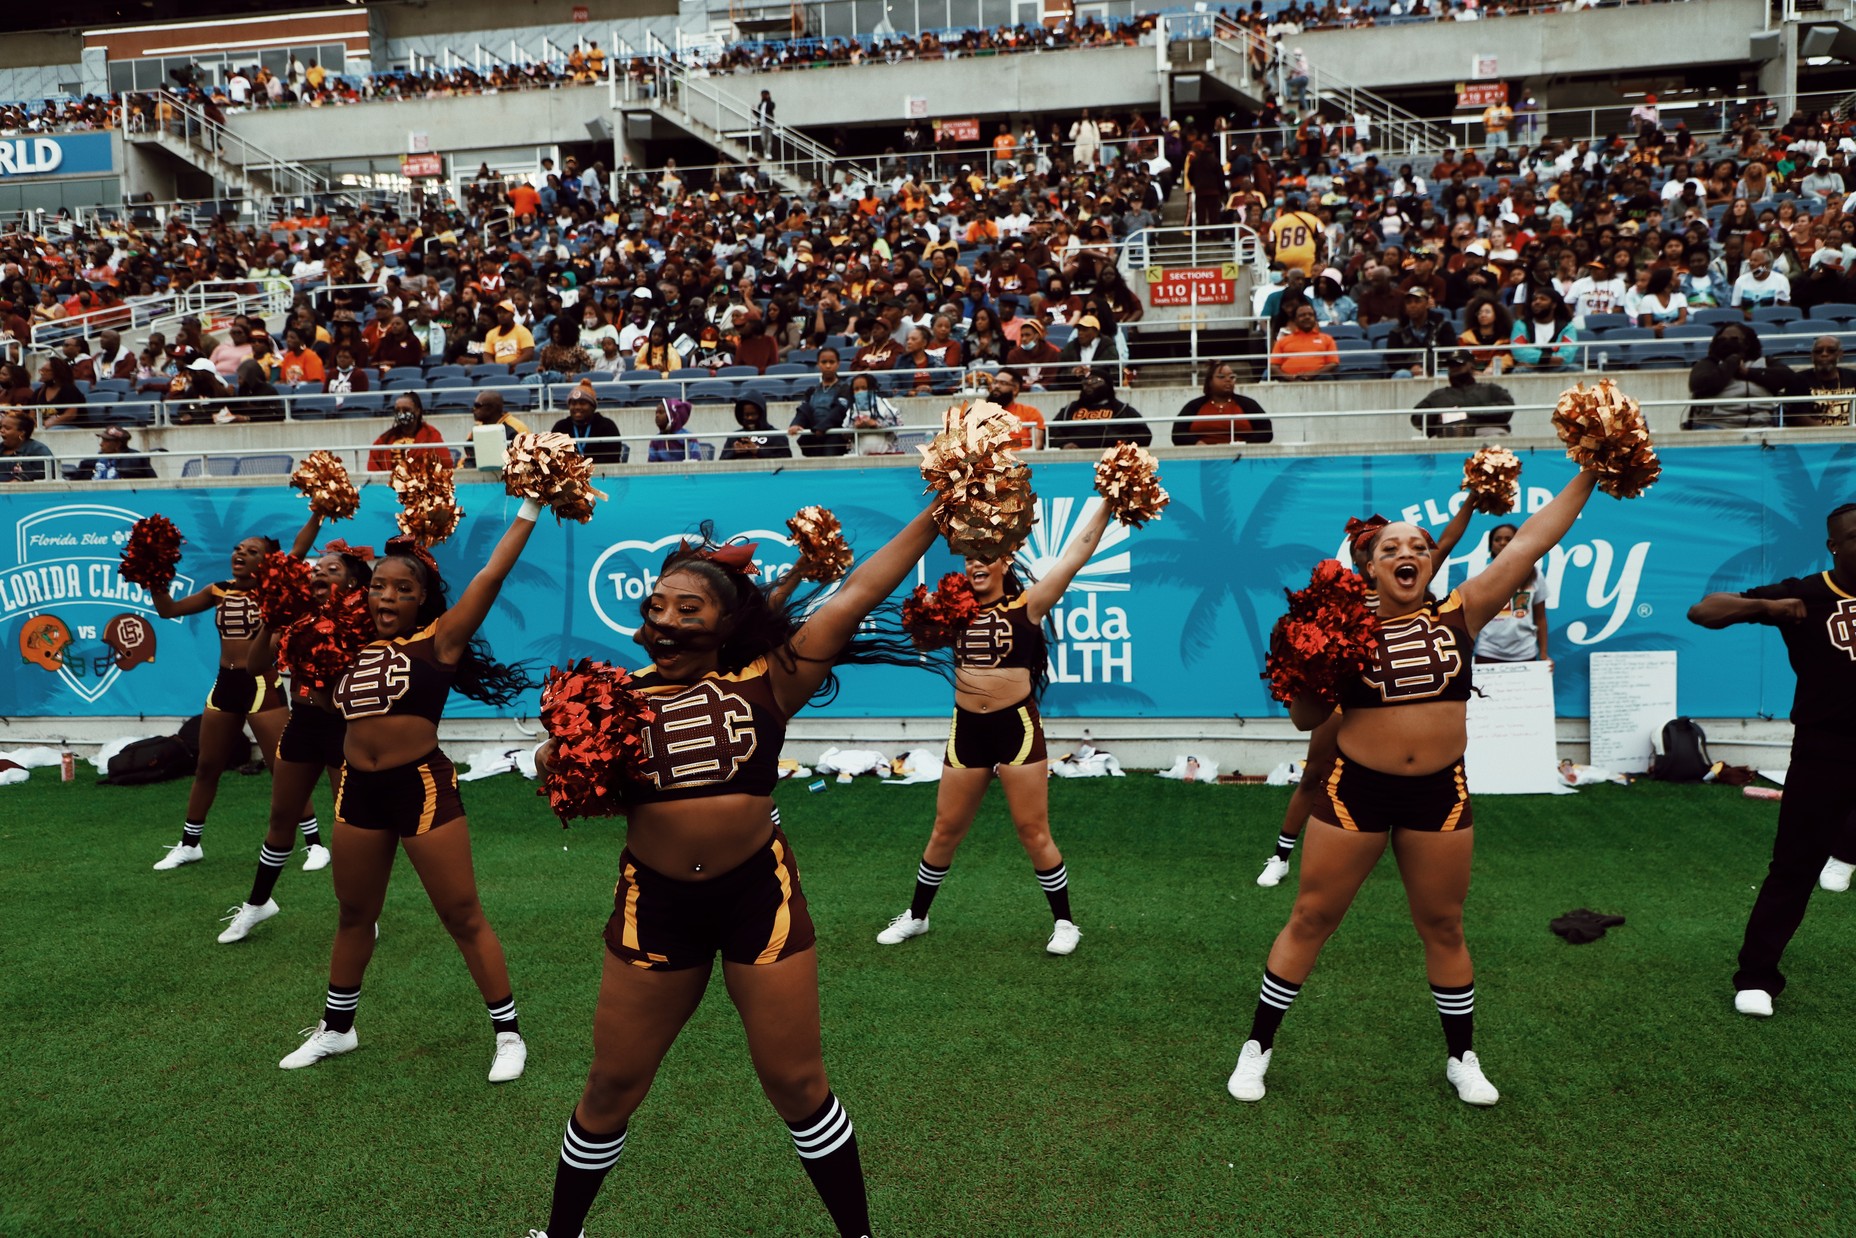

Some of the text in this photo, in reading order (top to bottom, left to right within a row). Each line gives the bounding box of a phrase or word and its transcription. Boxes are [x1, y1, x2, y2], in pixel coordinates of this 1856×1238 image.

[1280, 226, 1307, 249] 68
[1169, 271, 1215, 281] SECTIONS
[1156, 282, 1227, 297] 110 111
[29, 532, 108, 546] Florida Blue
[0, 563, 82, 613] LORIDA
[1047, 642, 1133, 684] LTH
